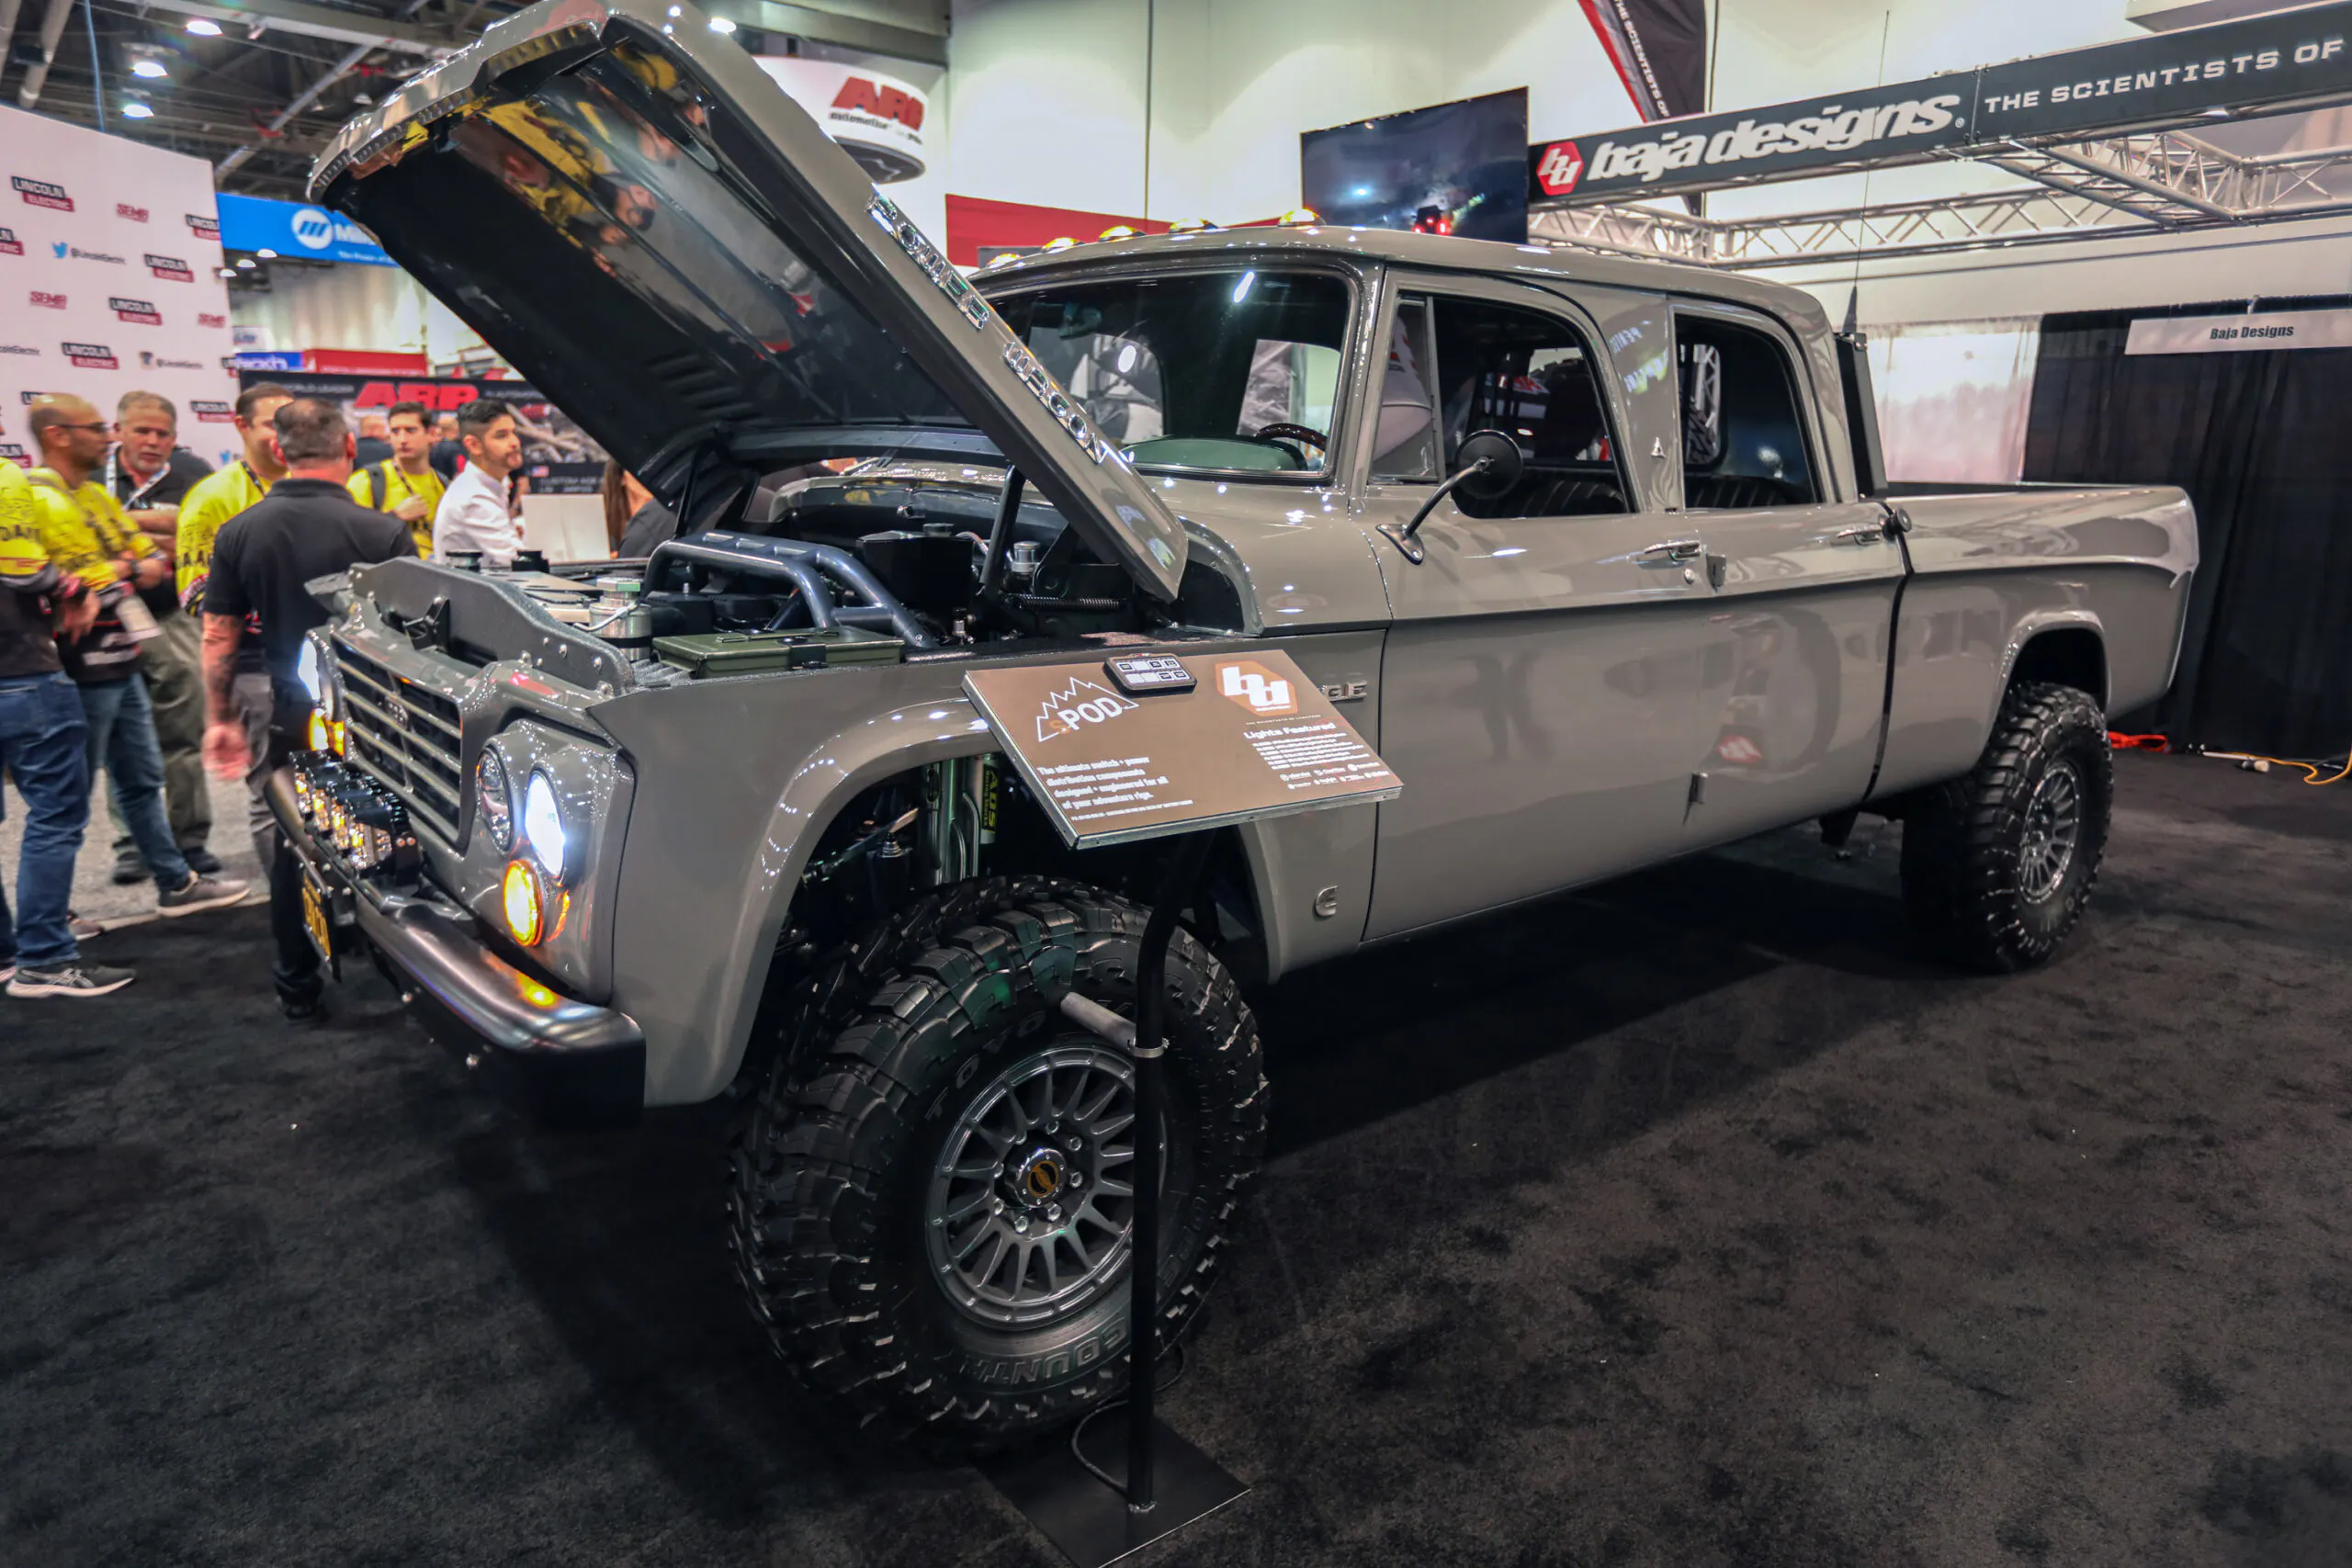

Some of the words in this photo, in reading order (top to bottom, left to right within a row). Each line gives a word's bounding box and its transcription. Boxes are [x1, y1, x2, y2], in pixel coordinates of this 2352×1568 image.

[1984, 90, 2041, 114] THE
[2051, 51, 2279, 104] SCIENTISTS
[2292, 39, 2345, 64] OF
[1703, 95, 1962, 165] designs
[2210, 328, 2239, 340] Baja
[2241, 325, 2295, 340] Designs
[355, 381, 480, 410] ARP
